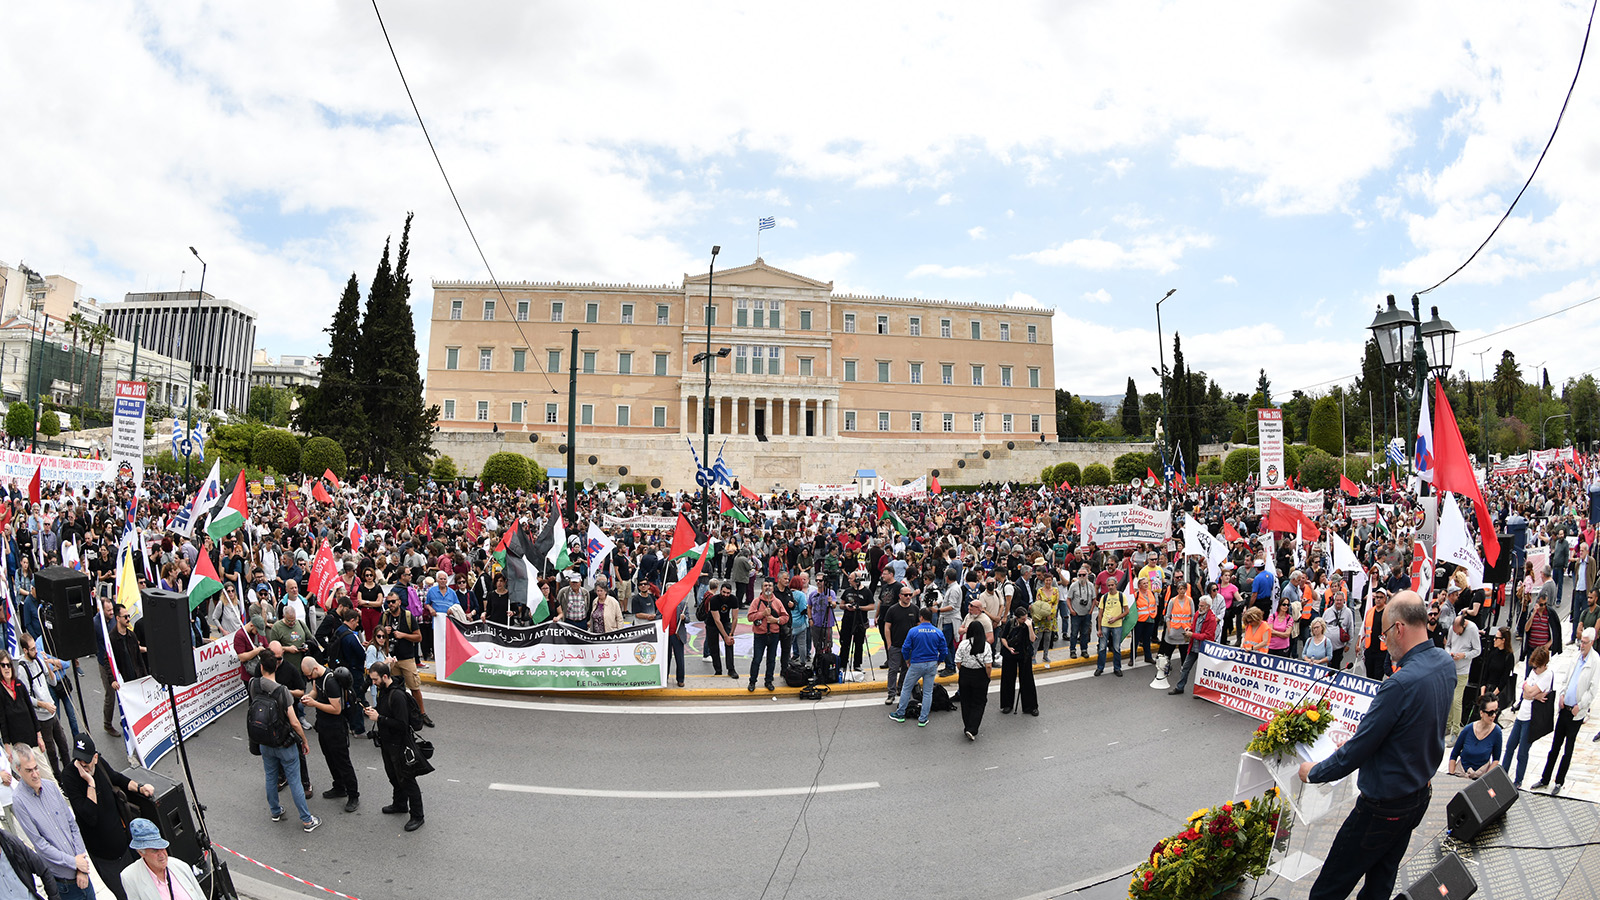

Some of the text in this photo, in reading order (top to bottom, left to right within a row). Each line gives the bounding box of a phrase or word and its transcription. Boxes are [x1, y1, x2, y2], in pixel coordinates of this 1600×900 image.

[132, 384, 146, 396] 2024
[1122, 516, 1164, 528] Καισαριανή
[1128, 508, 1153, 520] Σικάγο
[464, 626, 526, 643] الحرية لفلسطين
[535, 628, 572, 640] ΛΕΥΤΕΡΙΑ
[599, 627, 655, 641] ΠΑΛΑΙΣΤΙΝΗ
[509, 652, 527, 663] غزة
[551, 648, 587, 663] المجازر
[591, 646, 620, 663] أوقفوا
[478, 665, 524, 678] Σταματήστε
[526, 669, 548, 679] τώρα
[560, 668, 590, 678] σφαγές
[606, 668, 627, 677] Γάζα
[1204, 643, 1258, 665] ΜΠΡΟΣΤΑ
[1260, 656, 1274, 670] ΟΙ
[1276, 659, 1313, 678] ΔΙΚΕΣ
[1339, 675, 1381, 696] ΑΝΑΓΚ
[1203, 668, 1260, 690] ΕΠΑΝΑΦΟΡΑ
[1264, 684, 1281, 696] ΤΟΥ
[1232, 665, 1356, 706] ΑΥΞΗΣΕΙΣ ΣΤΟΥΣ ΜΙΣΘΟΥΣ
[1199, 678, 1229, 692] ΚΑΛΥΨΗ
[1230, 686, 1252, 699] ΟΛΩΝ
[1253, 693, 1267, 703] ΤΩΝ
[1218, 694, 1275, 720] ΣΥΝΔΙΚΑΤΟ
